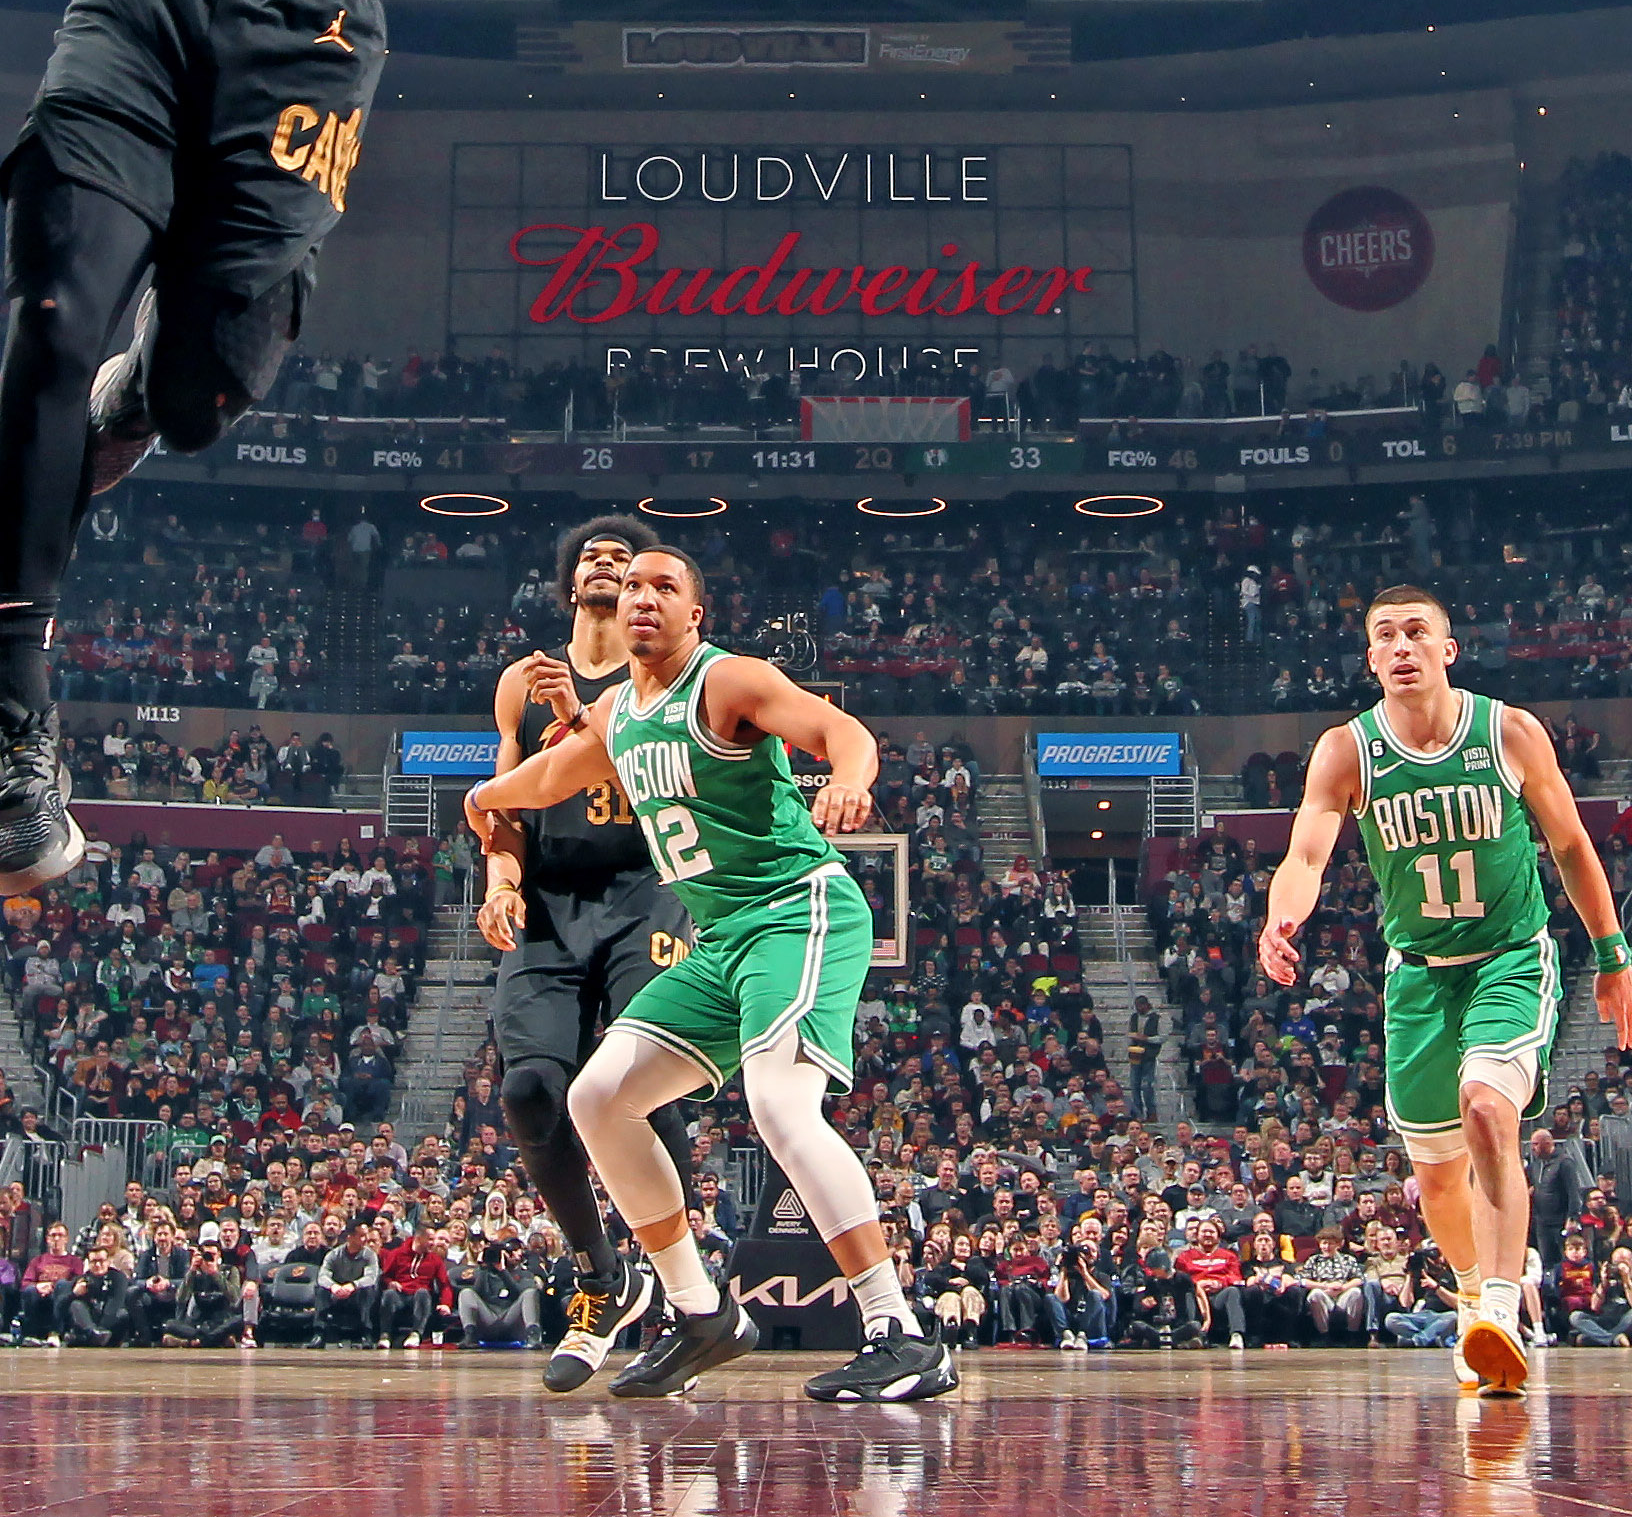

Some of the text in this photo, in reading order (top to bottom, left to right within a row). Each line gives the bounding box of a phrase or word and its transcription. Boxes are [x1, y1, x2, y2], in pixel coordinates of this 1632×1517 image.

[879, 43, 971, 63] FirstEnergy
[601, 153, 988, 202] LOUDVILLE
[1319, 228, 1413, 270] CHEERS
[509, 222, 1094, 325] Budweiser
[236, 444, 307, 465] FOULS
[373, 448, 465, 470] FG% 41
[581, 447, 614, 471] 26
[855, 448, 894, 470] 2Q
[1008, 447, 1042, 470] 33
[1240, 446, 1310, 467] FOULS
[1382, 439, 1426, 459] TOL
[686, 450, 714, 469] 17
[752, 450, 817, 469] 11:31
[1108, 450, 1157, 469] FG%
[136, 706, 182, 723] M113
[665, 701, 687, 716] VISTA
[1040, 745, 1172, 764] PROGRESSIVE
[1371, 740, 1384, 756] 6
[1461, 746, 1491, 762] VISTA
[1464, 757, 1492, 773] PRINT
[585, 781, 634, 826] 31
[1372, 784, 1503, 852] BOSTON
[641, 804, 715, 886] 12
[1414, 849, 1485, 920] 11
[768, 1226, 809, 1235] DENNISON
[775, 1220, 802, 1228] AVERY
